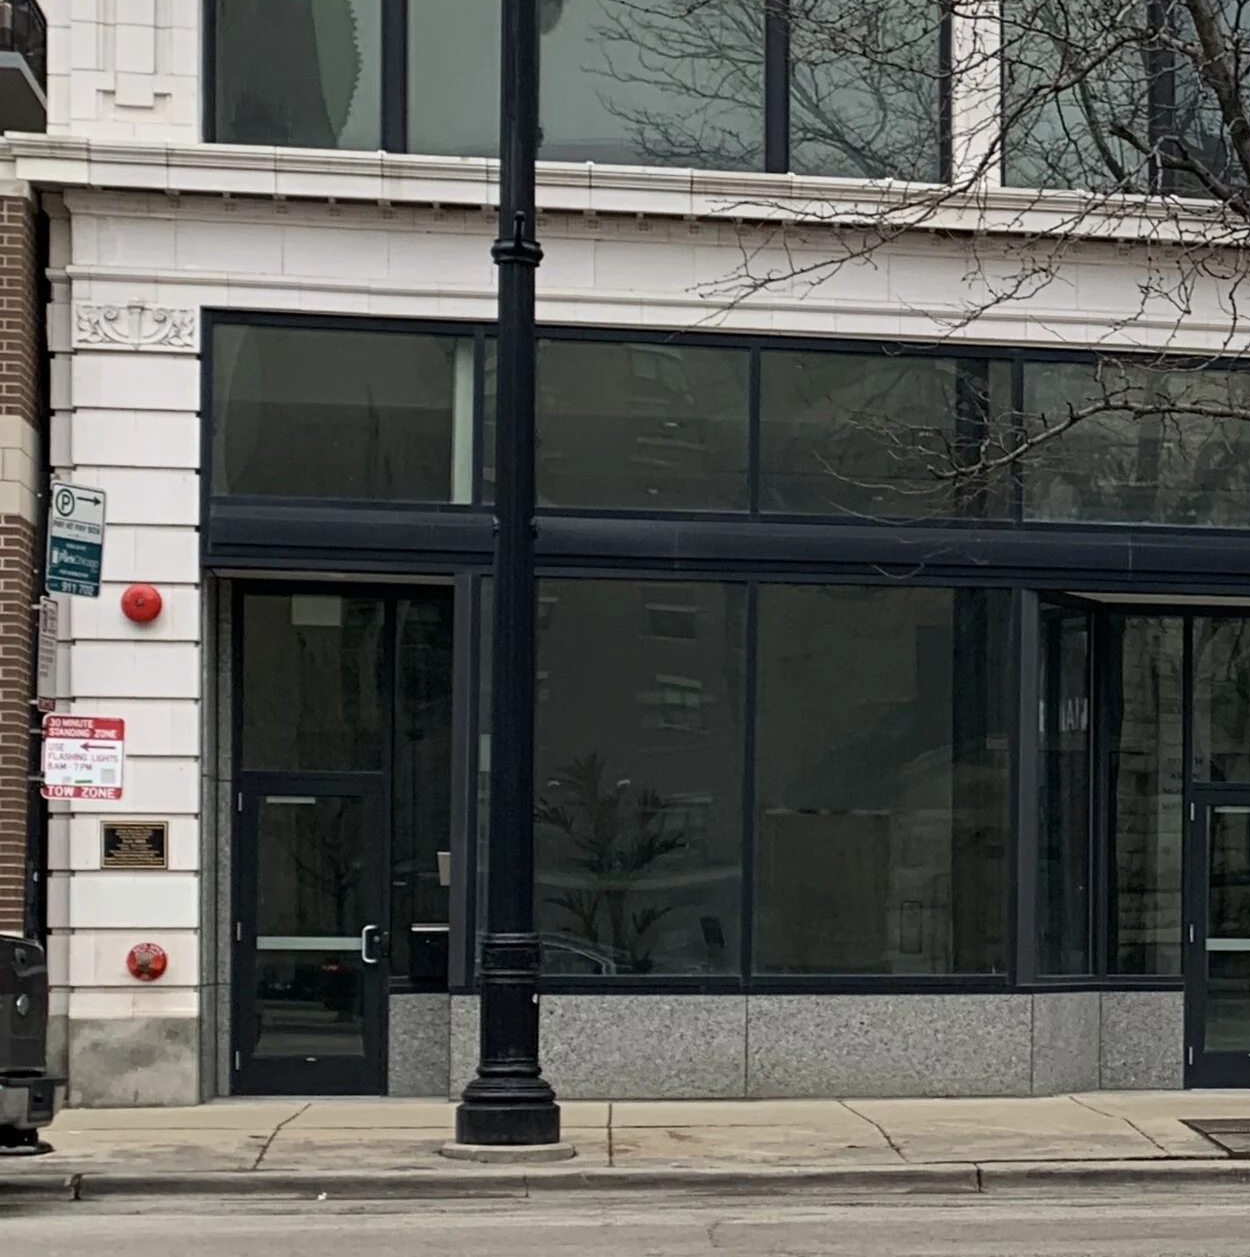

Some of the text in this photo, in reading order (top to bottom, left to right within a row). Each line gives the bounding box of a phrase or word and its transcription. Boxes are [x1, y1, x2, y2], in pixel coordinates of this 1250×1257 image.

[50, 718, 94, 729] 30 MINUTE
[48, 728, 117, 739] STANDING ZONE
[48, 753, 118, 763] FLASHING LIGHTS
[47, 786, 116, 799] TOW ZONE
